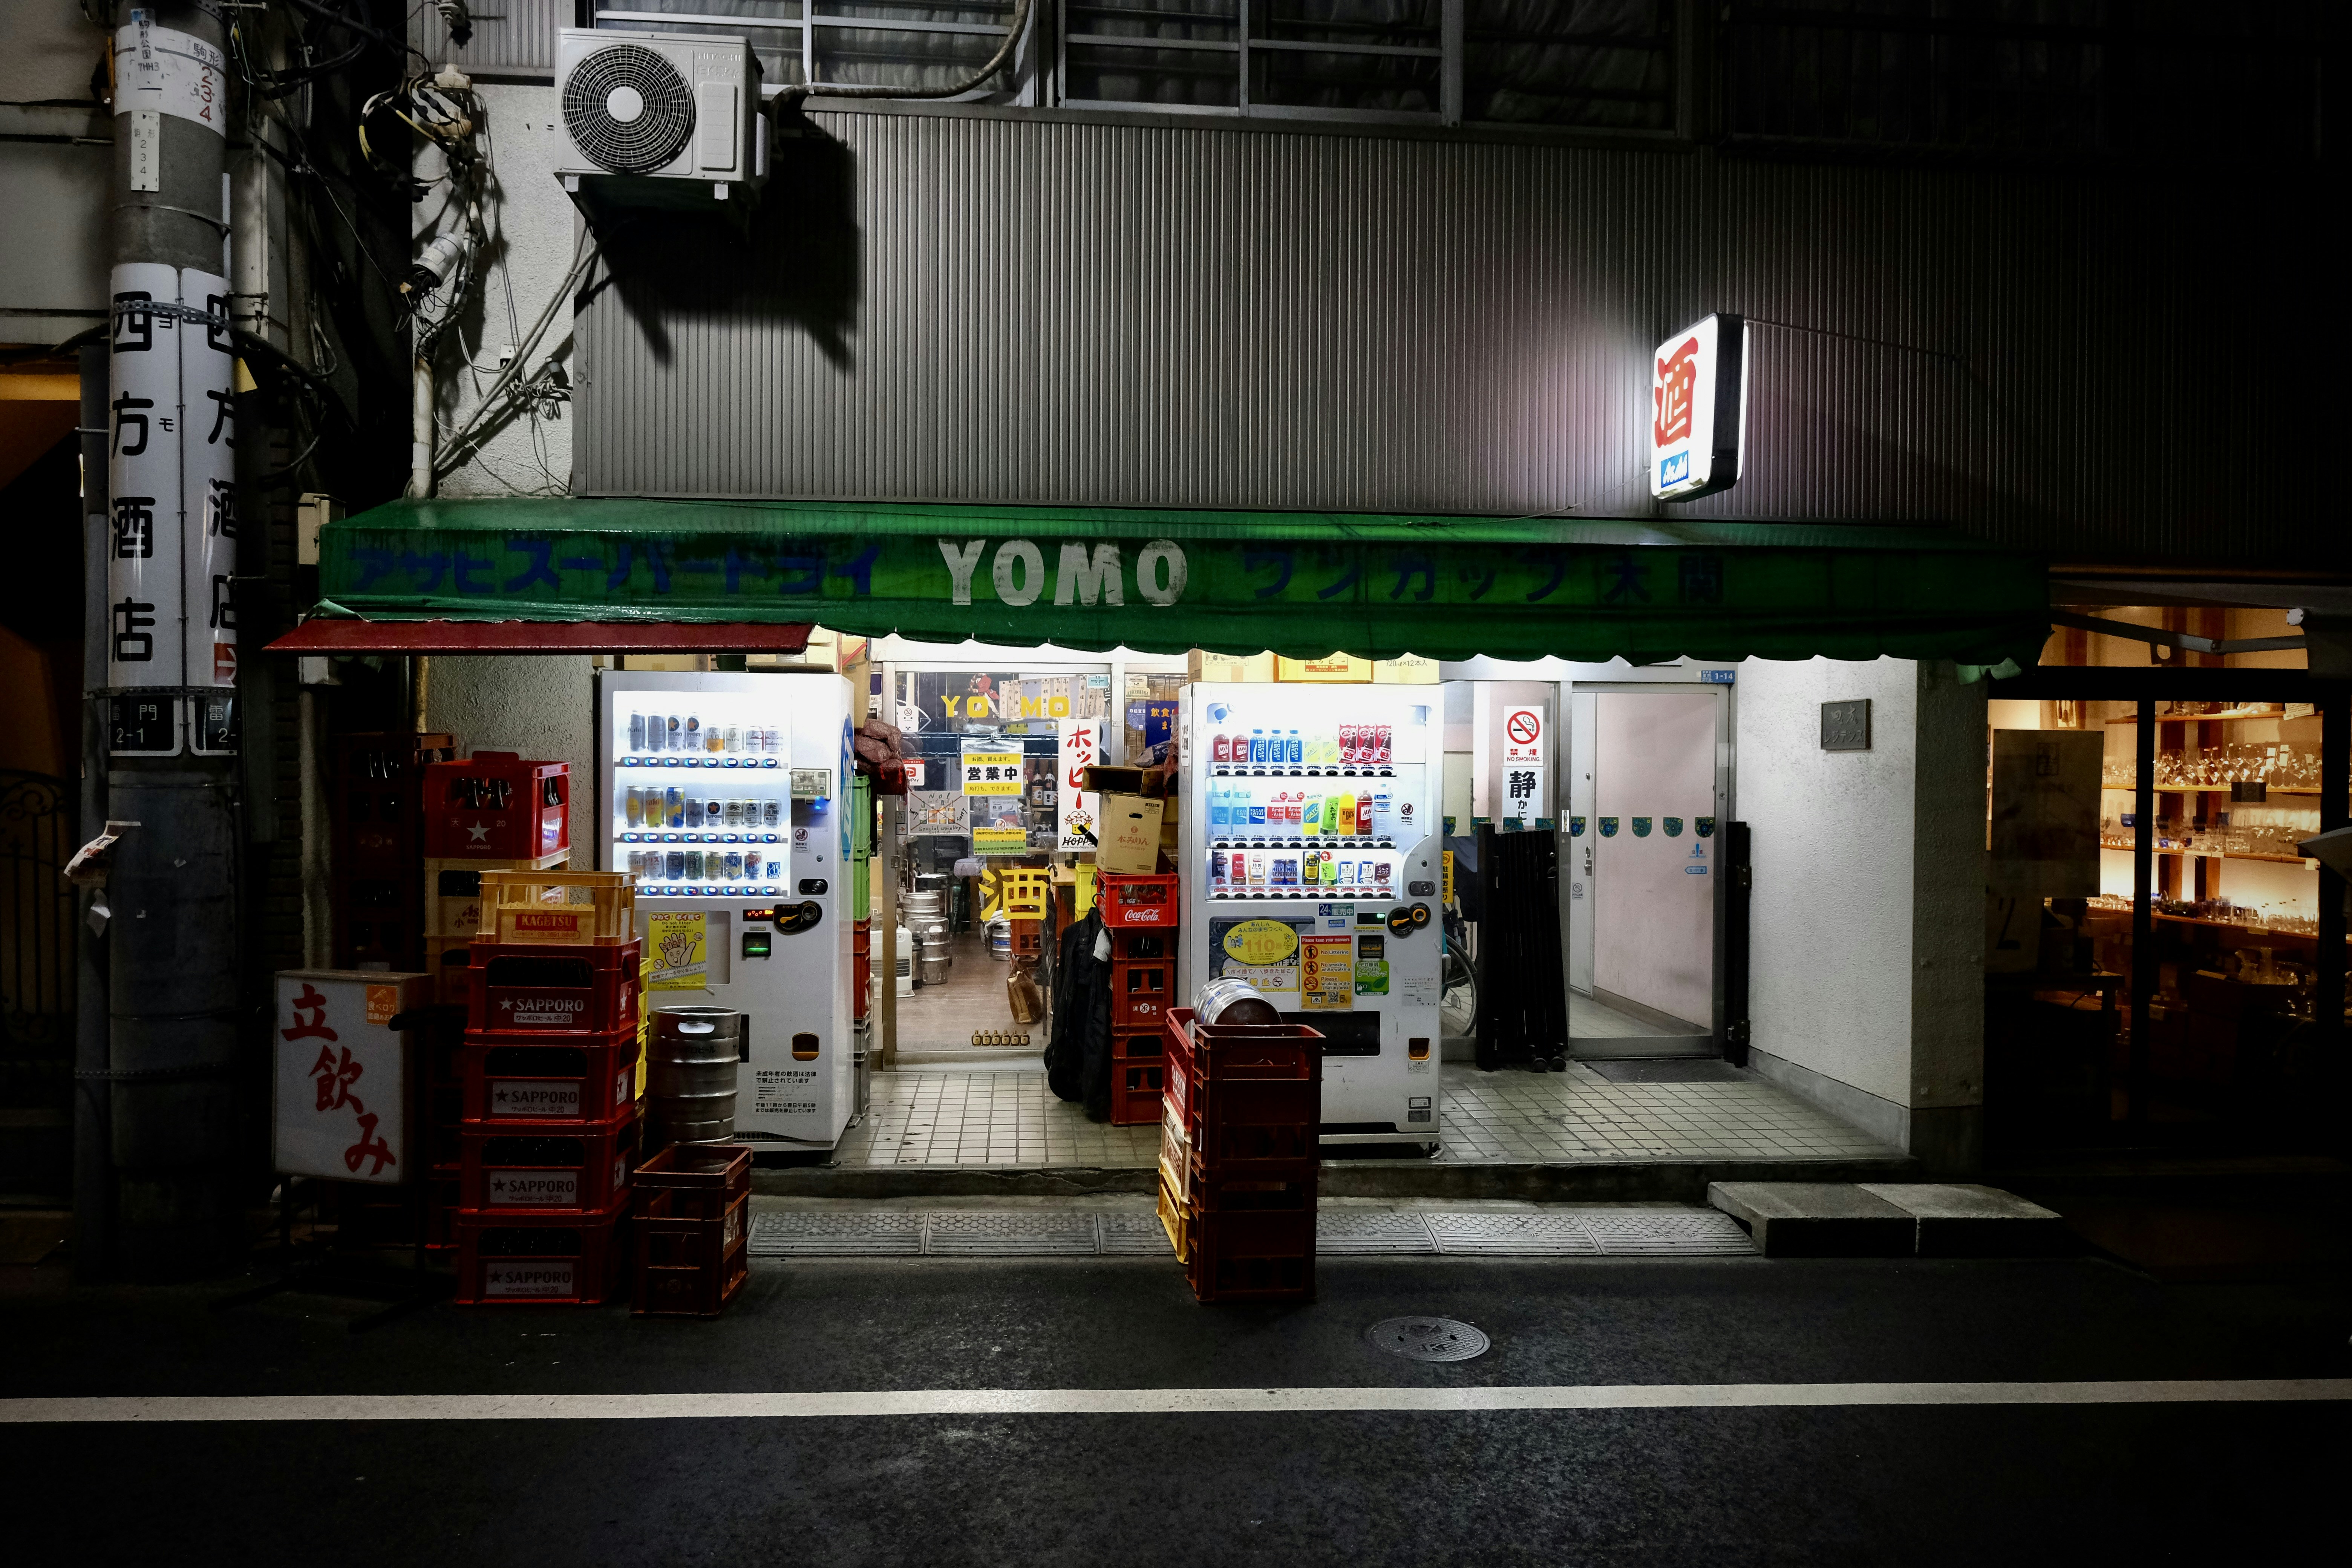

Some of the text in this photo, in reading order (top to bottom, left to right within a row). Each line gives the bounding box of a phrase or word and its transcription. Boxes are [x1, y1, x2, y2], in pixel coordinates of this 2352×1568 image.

[193, 43, 222, 67] 駒形
[1654, 336, 1699, 449] 酒
[936, 538, 1188, 607] YOMO
[941, 695, 1069, 717] YOMO
[967, 766, 1017, 781] 営業中
[1509, 771, 1536, 821] 静かに
[1117, 835, 1150, 846] 本みりん
[978, 868, 1050, 921] 酒
[522, 915, 572, 926] KAGETSU
[1125, 909, 1160, 922] Coca-Cola
[516, 999, 584, 1012] SAPPORO
[280, 983, 397, 1177] 立飲み
[511, 1091, 577, 1103] SAPPORO
[509, 1180, 575, 1193] SAPPORO
[506, 1271, 571, 1283] SAPPORO
